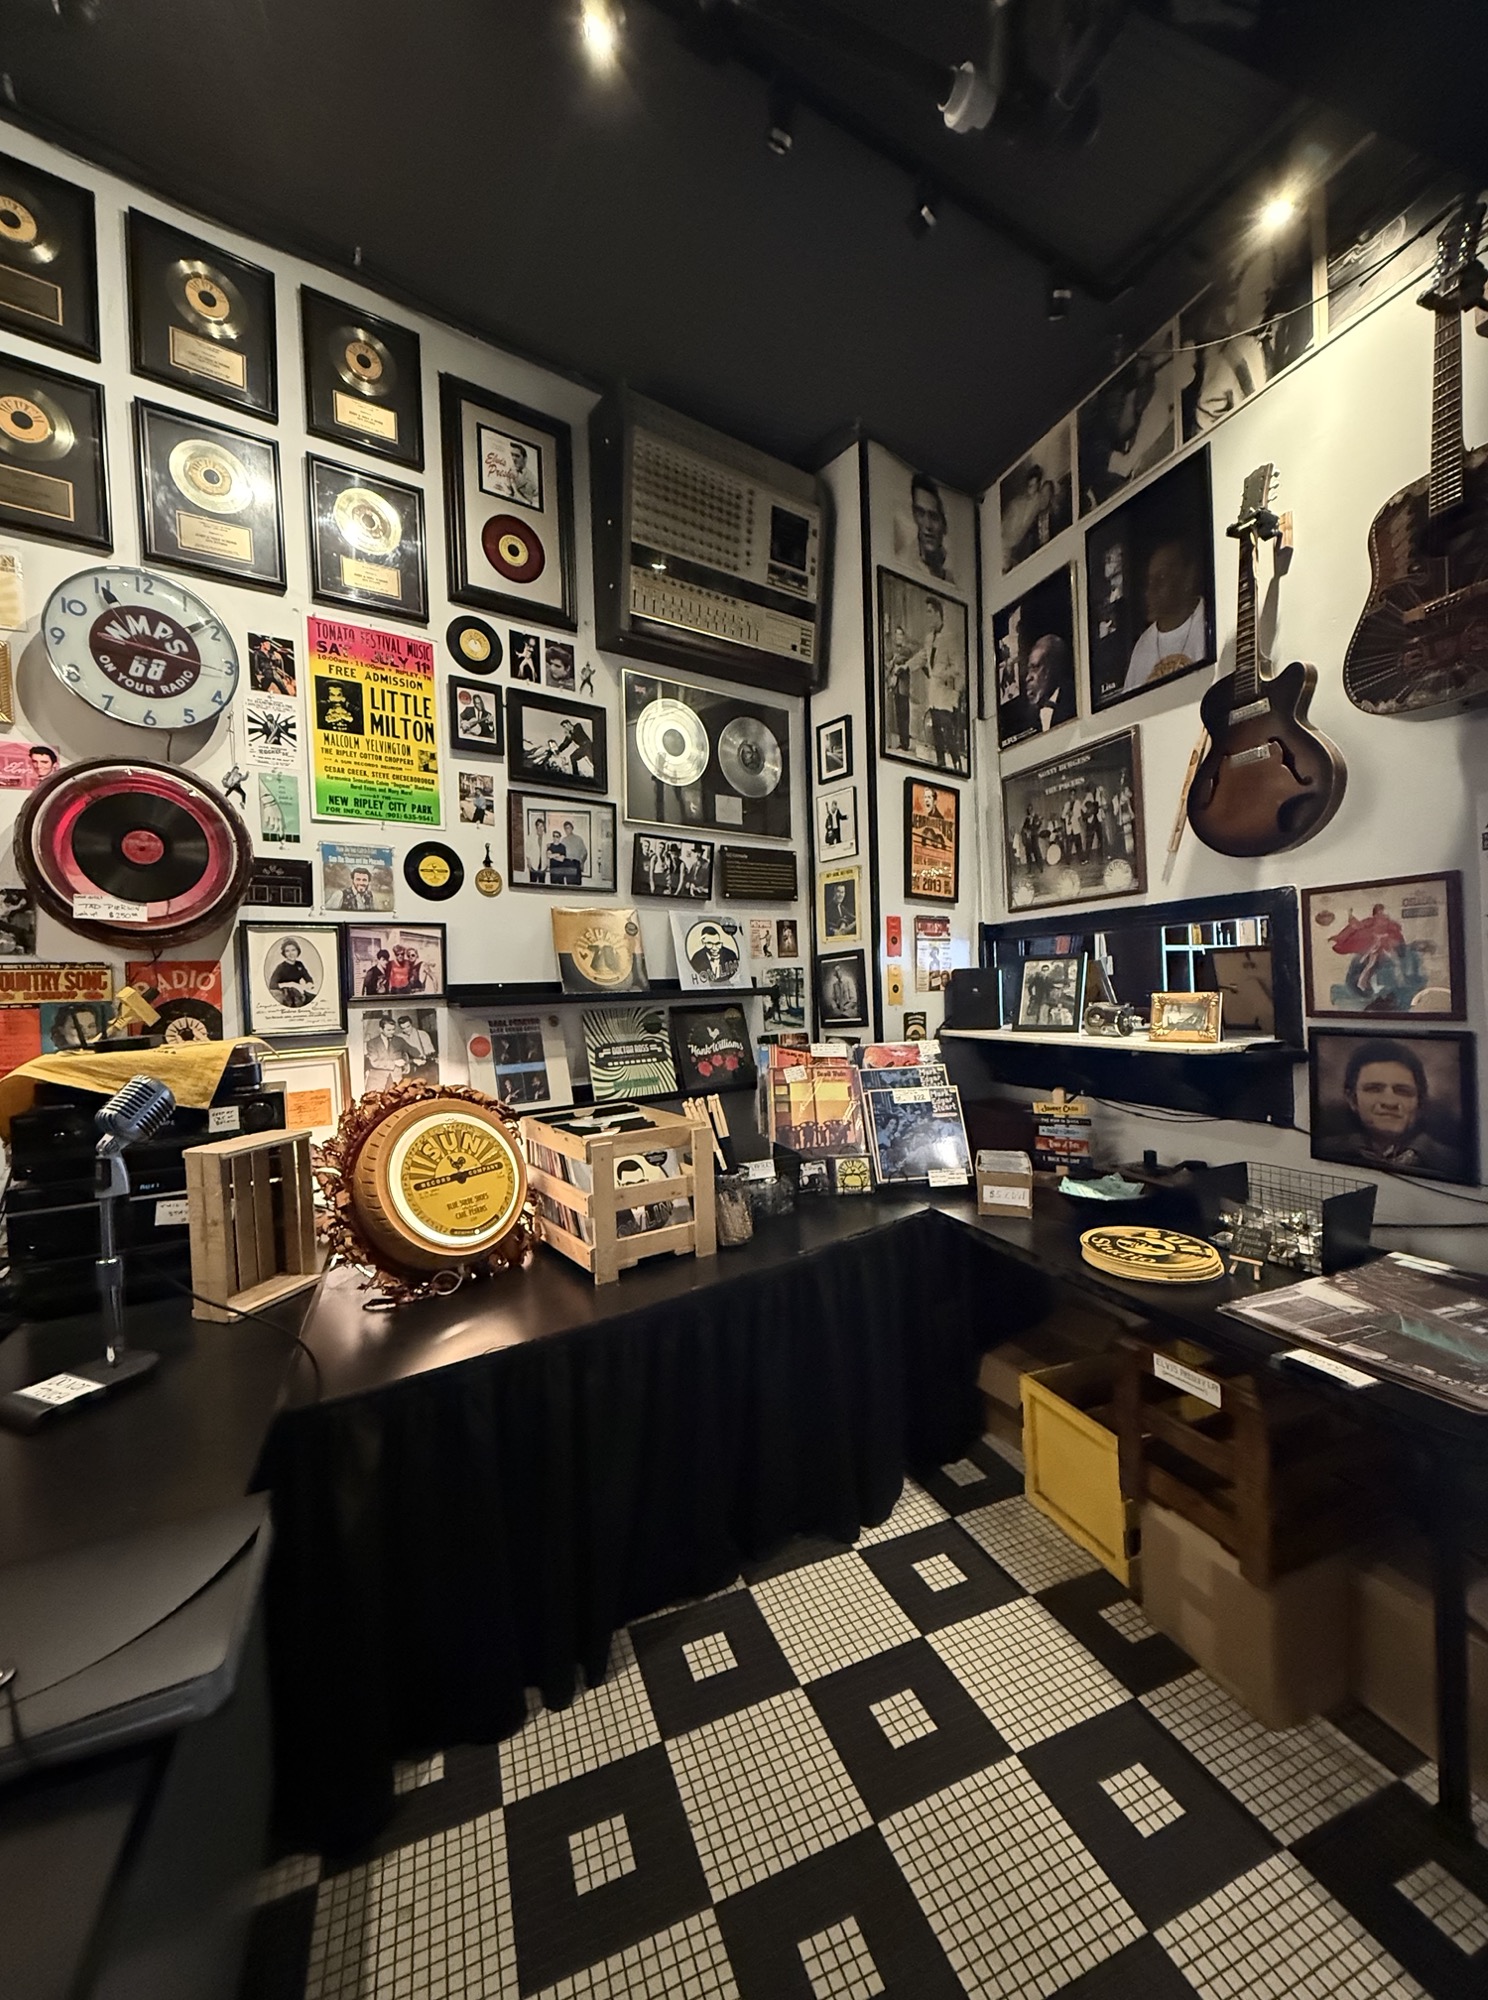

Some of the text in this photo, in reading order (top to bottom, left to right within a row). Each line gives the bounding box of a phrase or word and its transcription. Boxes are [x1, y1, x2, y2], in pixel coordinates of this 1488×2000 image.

[135, 576, 154, 595] 12
[61, 596, 87, 617] 10
[50, 627, 65, 645] 9
[210, 626, 221, 642] 2
[316, 621, 431, 662] TOMATO FESTIVAL MUSIC
[100, 655, 194, 695] ON YOUR RADIO
[128, 655, 168, 681] 68
[224, 660, 235, 676] 3
[328, 664, 423, 691] FREE ADMISSION
[1101, 682, 1116, 693] Lisa
[101, 694, 114, 711] 7
[211, 690, 224, 706] 4
[370, 687, 432, 720] LITTLE
[143, 709, 157, 726] 6
[183, 708, 196, 724] 5
[370, 712, 435, 745] MILTON
[323, 732, 411, 757] MALCOLM YELVINGTON
[320, 746, 414, 766] THE RIPLEY COTTON CHOPPERS
[324, 765, 346, 774] CEDAR
[372, 771, 390, 780] STEVE
[328, 794, 433, 815] NEW RIPLEY CITY PARK
[365, 810, 382, 818] CALL
[922, 877, 942, 893] 2013
[0, 971, 108, 992] OUNTRY SONG
[612, 1044, 650, 1056] DOCTOR ROSS
[688, 1038, 744, 1057] Hank Williams
[422, 1130, 482, 1160] SUN
[420, 1164, 500, 1189] RECORD COMPANY
[446, 1201, 459, 1211] BLUE
[474, 1192, 489, 1202] SHOES
[468, 1204, 488, 1216] PERKINS
[1092, 1236, 1157, 1264] Studio
